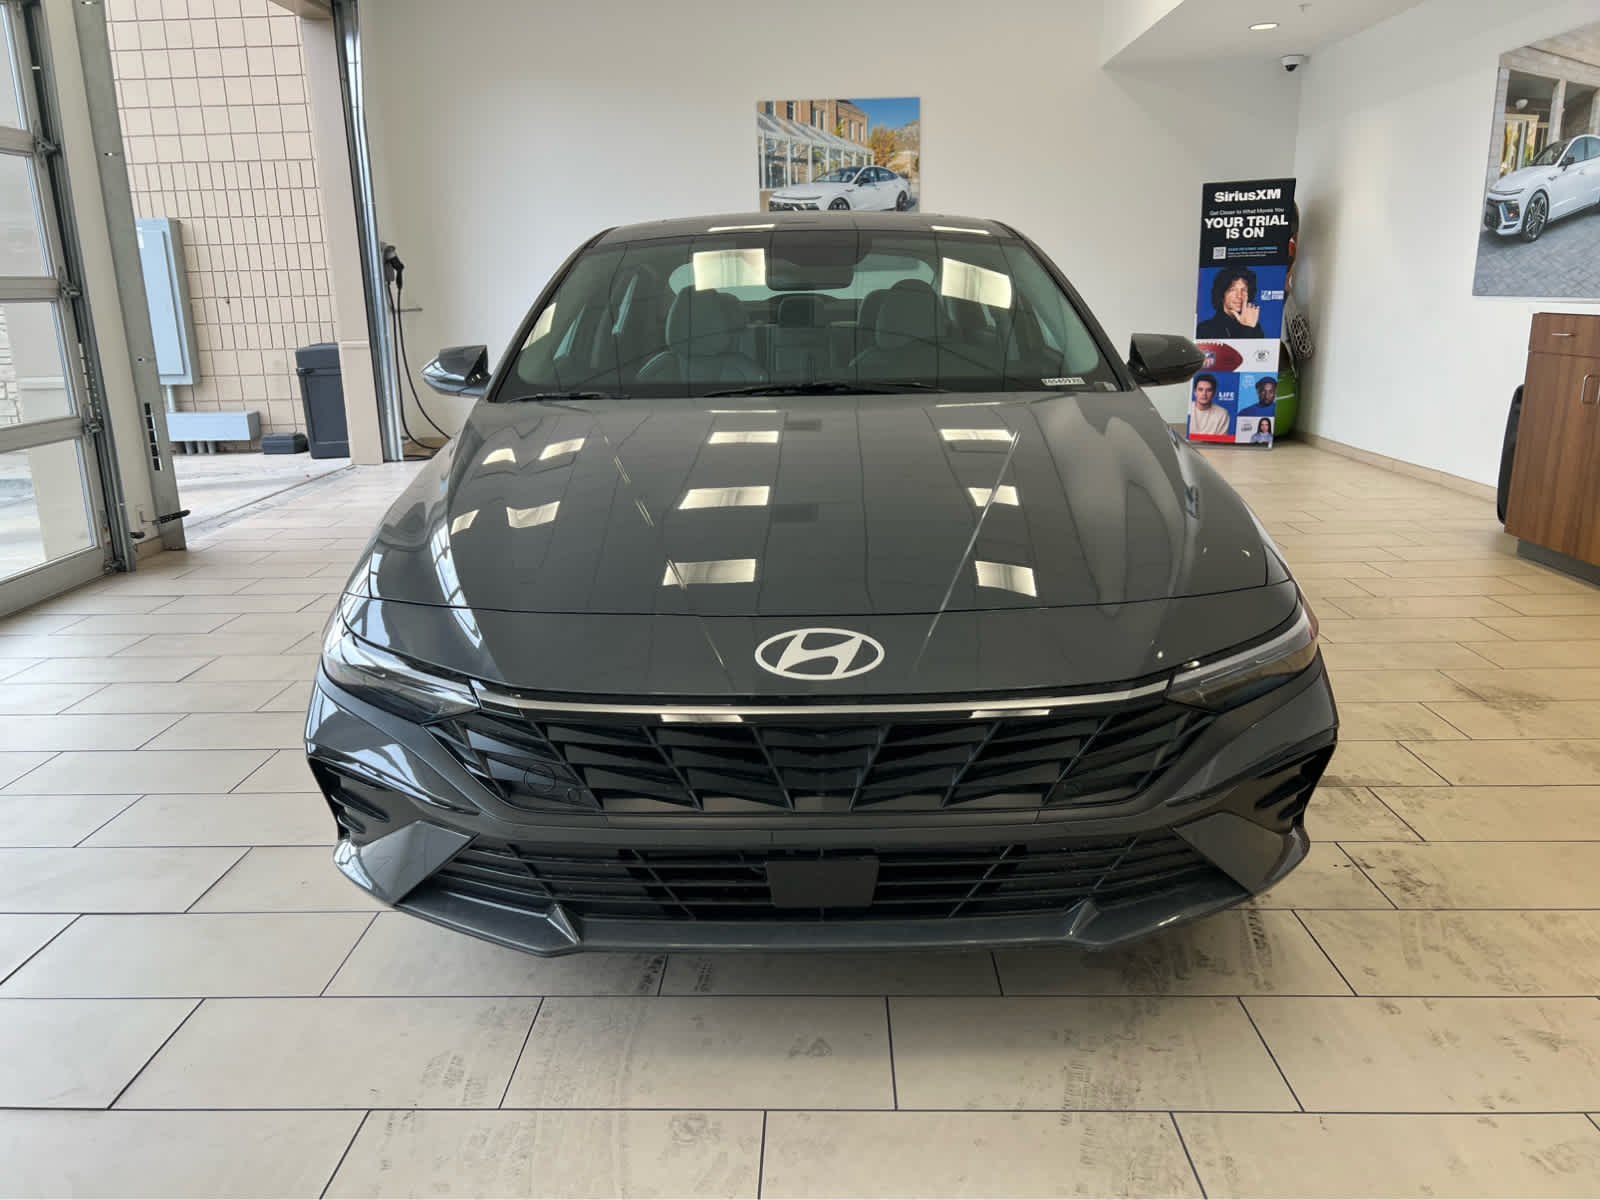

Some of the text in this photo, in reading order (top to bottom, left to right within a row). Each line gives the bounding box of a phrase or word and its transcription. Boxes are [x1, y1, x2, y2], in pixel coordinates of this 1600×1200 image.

[1214, 188, 1281, 202] SiriusXM
[1204, 214, 1289, 229] YOUR TRIAL
[1226, 226, 1265, 239] IS ON
